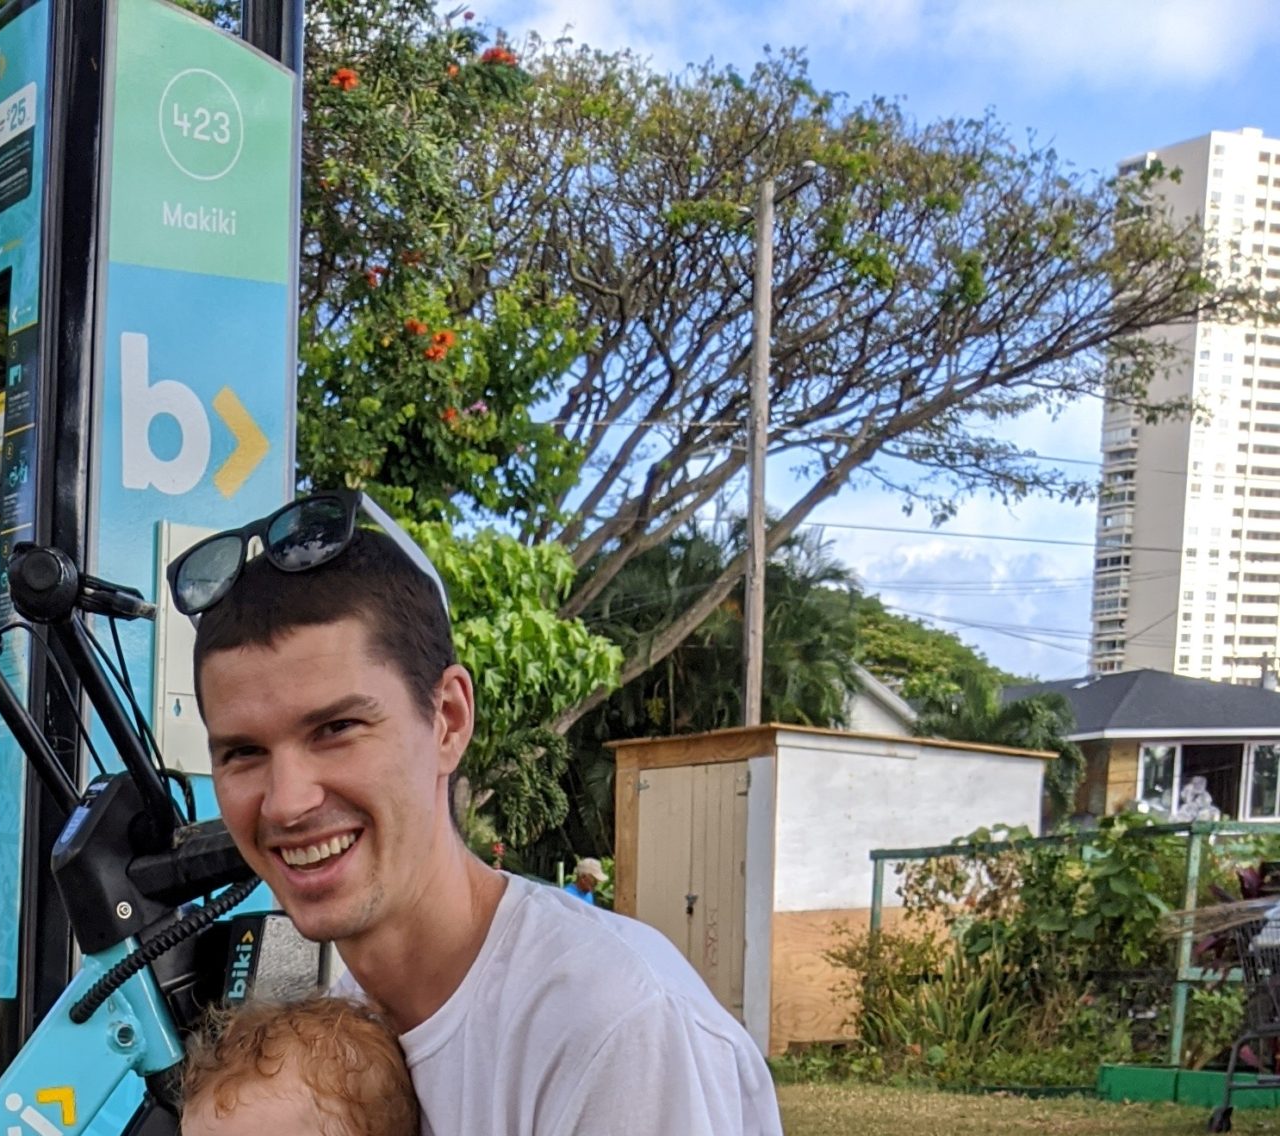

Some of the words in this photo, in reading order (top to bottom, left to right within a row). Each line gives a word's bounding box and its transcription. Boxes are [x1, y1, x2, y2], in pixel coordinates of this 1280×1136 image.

[172, 103, 231, 144] 423
[162, 201, 237, 236] Makiki
[120, 331, 212, 496] b
[228, 944, 253, 999] biki
